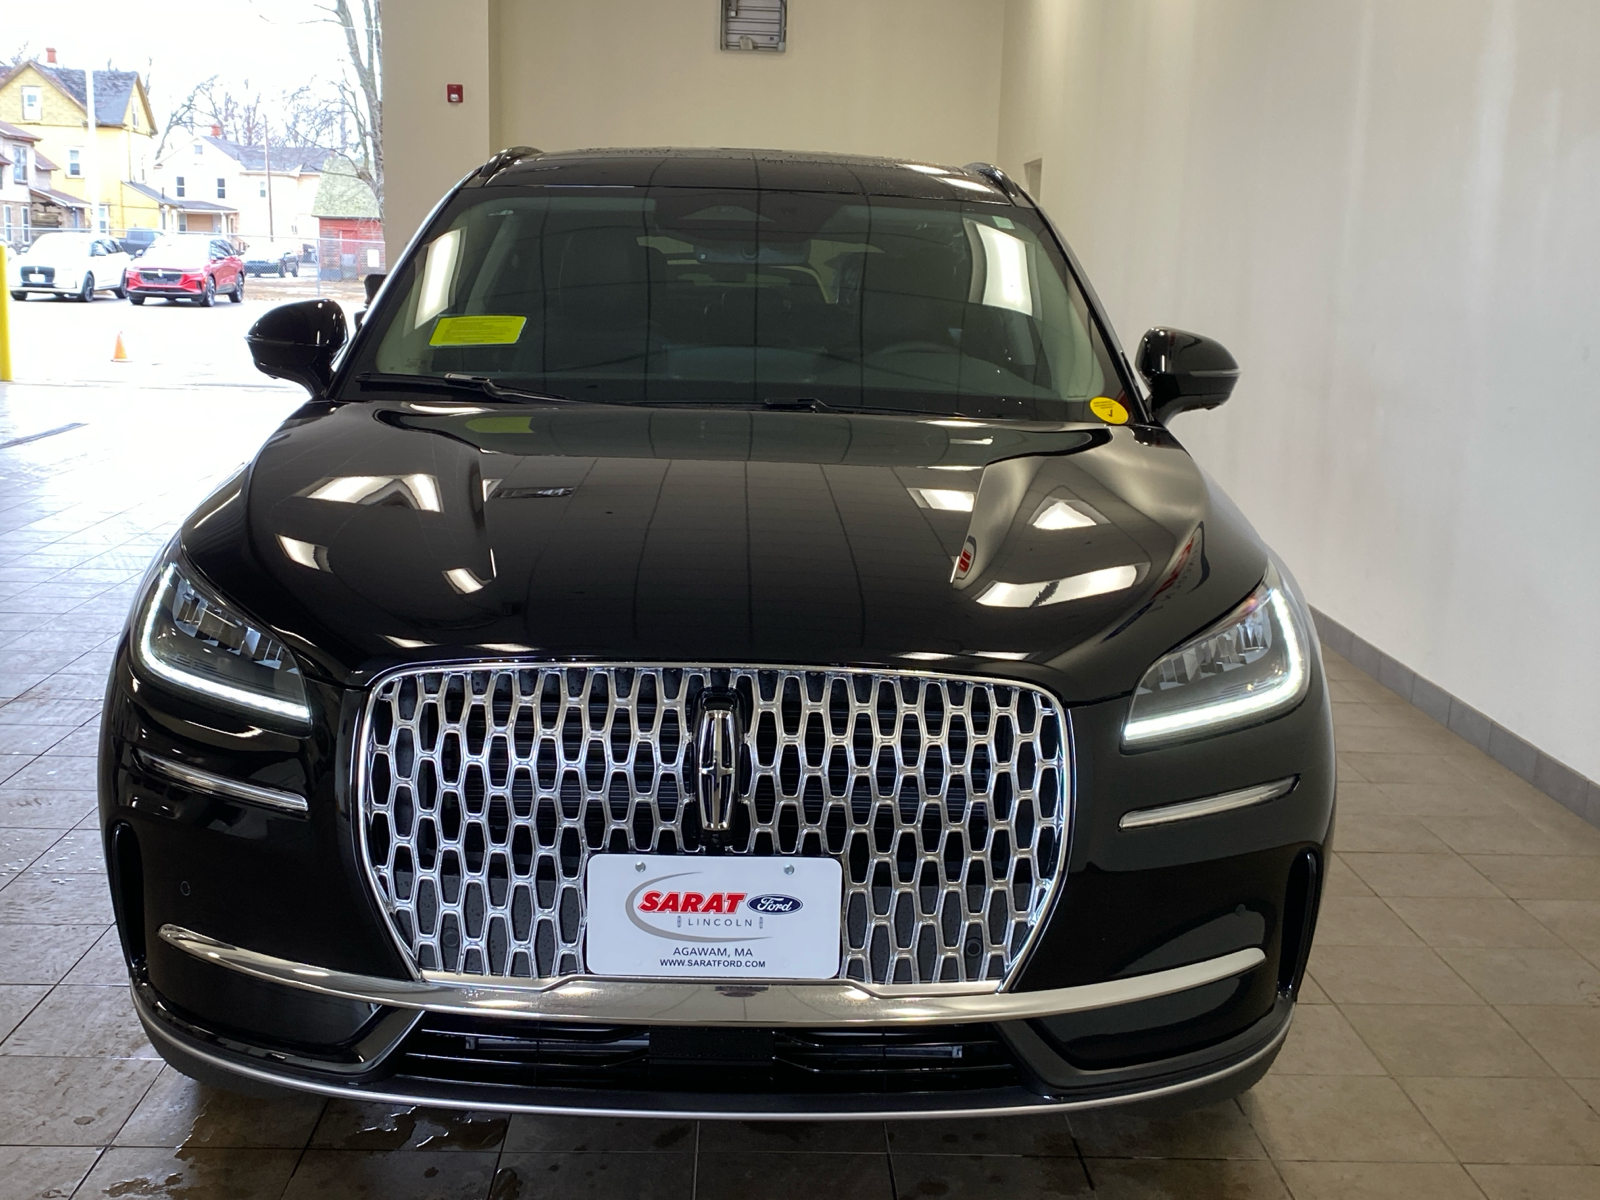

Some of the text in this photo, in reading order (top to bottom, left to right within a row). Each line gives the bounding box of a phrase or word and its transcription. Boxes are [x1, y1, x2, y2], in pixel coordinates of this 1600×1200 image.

[638, 891, 792, 914] SARAT Ford
[688, 918, 753, 927] LINCOLN
[672, 947, 754, 958] AGAWAM, MA
[659, 959, 766, 968] WWW.SARATFORD.COM
